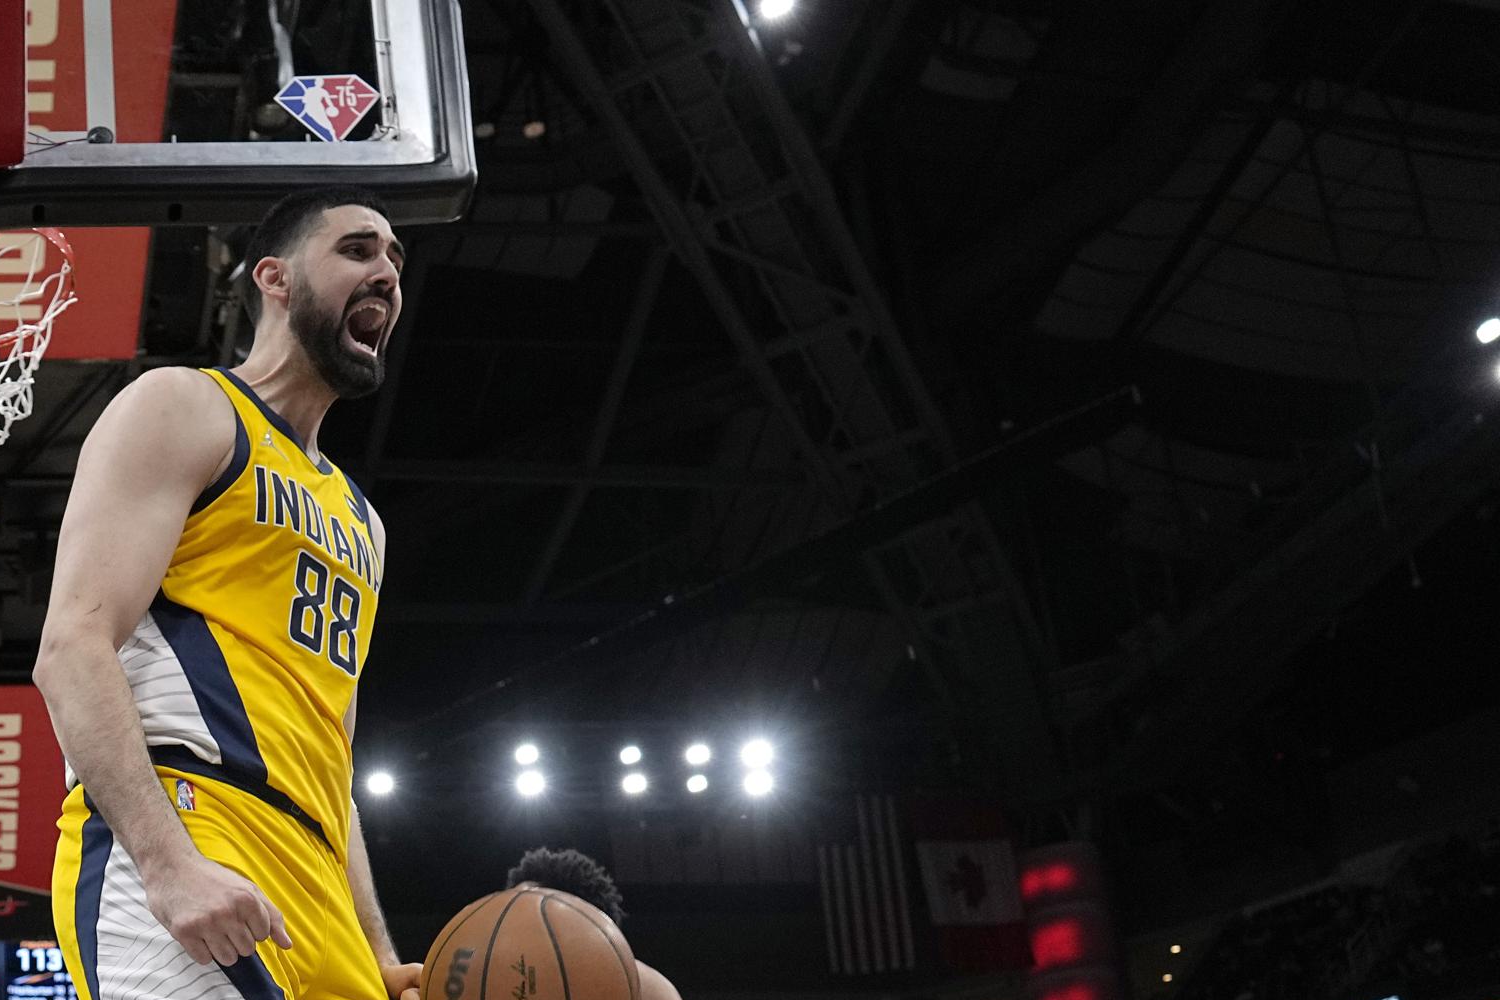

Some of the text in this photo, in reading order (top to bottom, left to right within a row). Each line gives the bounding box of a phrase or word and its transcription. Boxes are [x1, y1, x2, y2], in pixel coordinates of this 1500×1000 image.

[335, 85, 358, 107] 75
[289, 549, 361, 678] 88
[16, 948, 63, 972] 113
